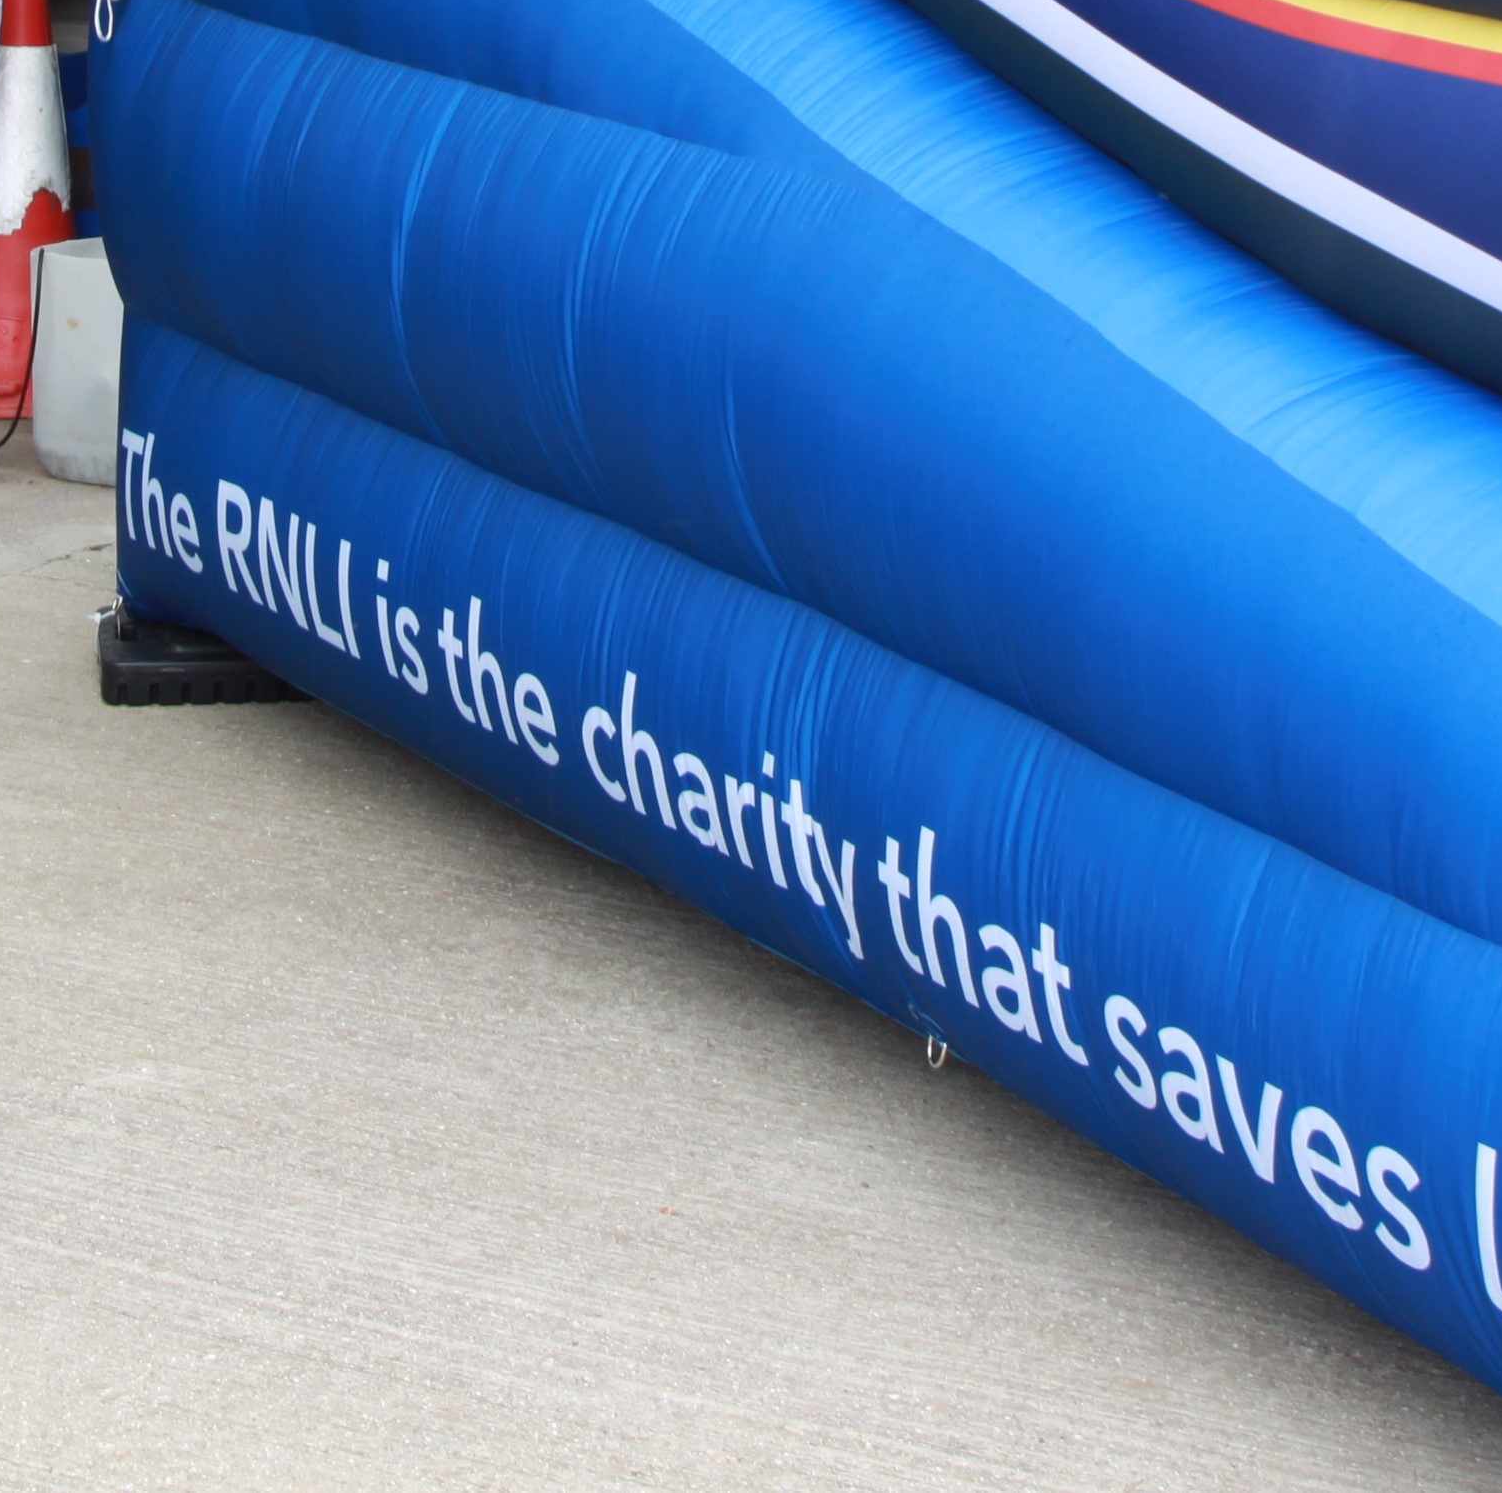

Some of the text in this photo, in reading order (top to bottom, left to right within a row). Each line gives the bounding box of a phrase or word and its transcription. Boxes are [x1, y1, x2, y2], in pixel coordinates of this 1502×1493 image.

[121, 428, 203, 573] The
[216, 478, 361, 660] RNLI
[375, 557, 429, 695] is
[437, 595, 560, 767] the
[581, 669, 865, 961] charity
[877, 825, 1090, 1067] that
[1103, 994, 1432, 1271] saves
